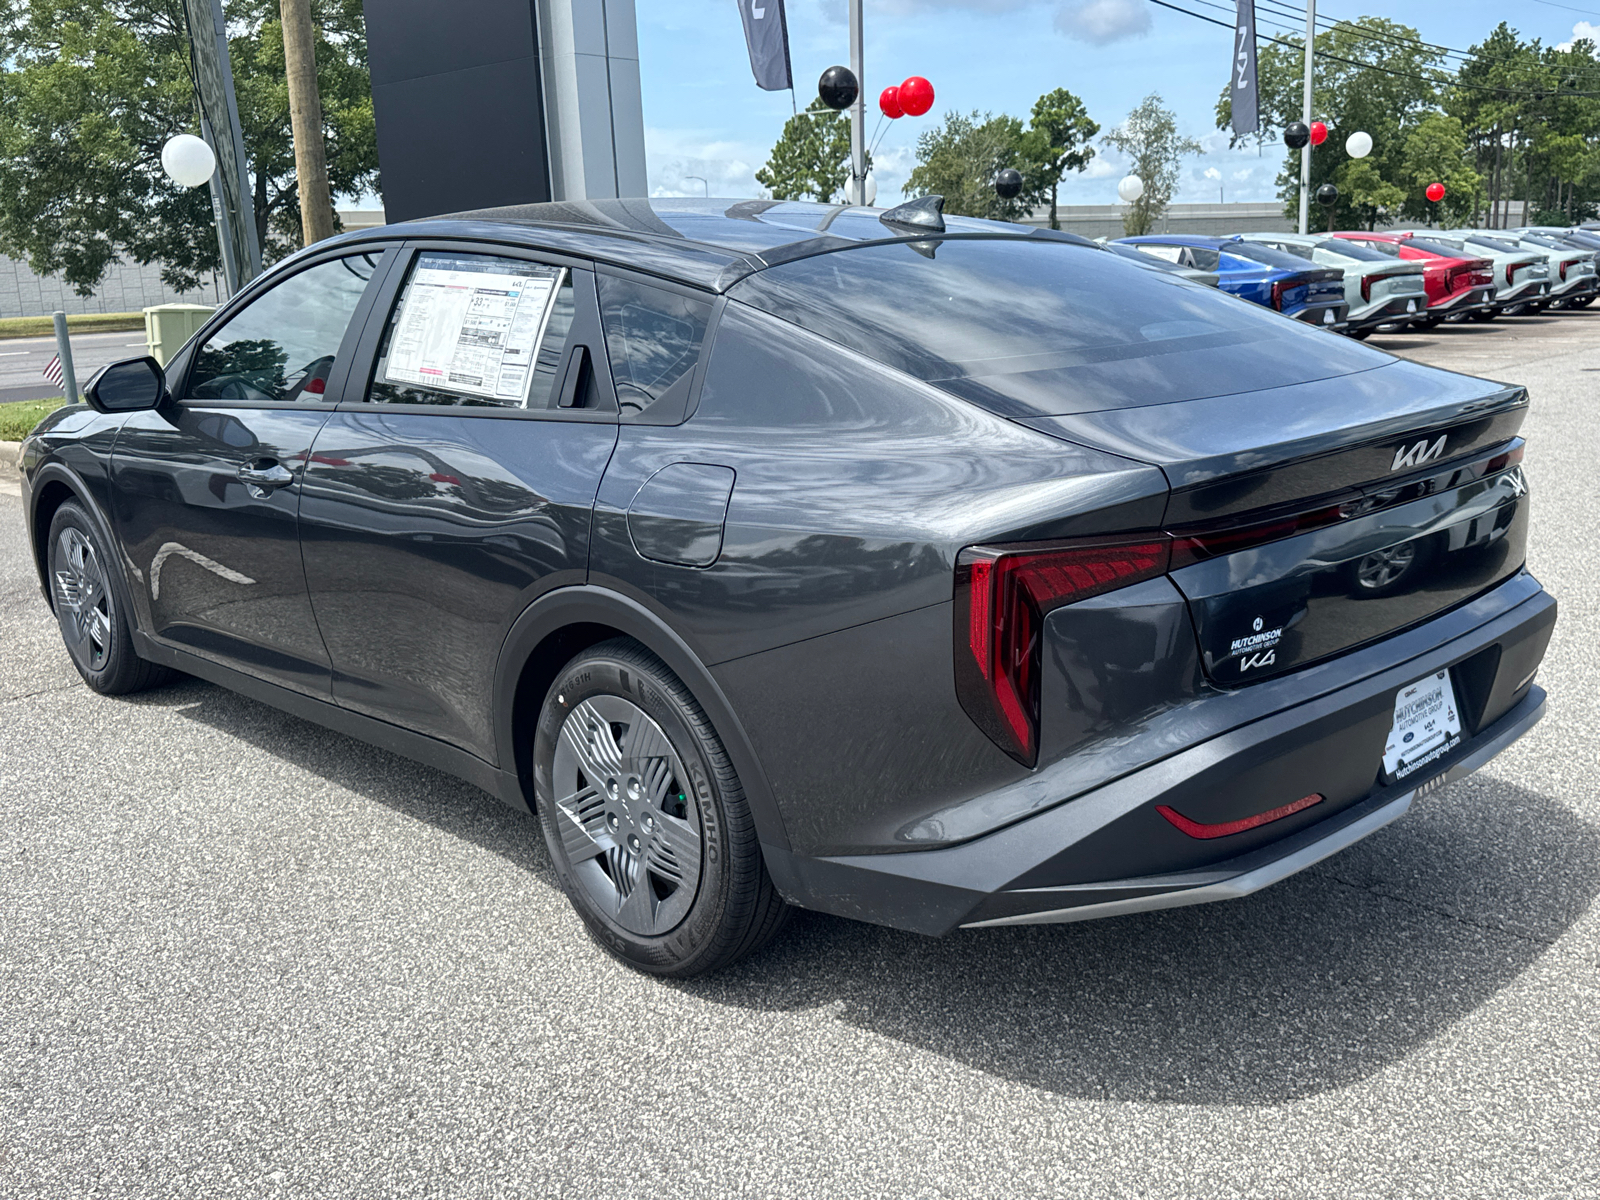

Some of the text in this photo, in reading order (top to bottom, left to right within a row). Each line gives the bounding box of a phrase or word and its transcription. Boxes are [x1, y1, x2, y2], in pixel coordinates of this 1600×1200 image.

[1391, 434, 1448, 471] KIA
[1231, 628, 1282, 650] HUTCHINSON
[1263, 638, 1280, 648] GROUP
[1240, 649, 1275, 672] K4
[1396, 686, 1443, 723] HUTCHINSON
[1399, 709, 1428, 732] AUTOMOTIVE
[1428, 701, 1442, 715] GROUP
[690, 761, 718, 864] KUMHO
